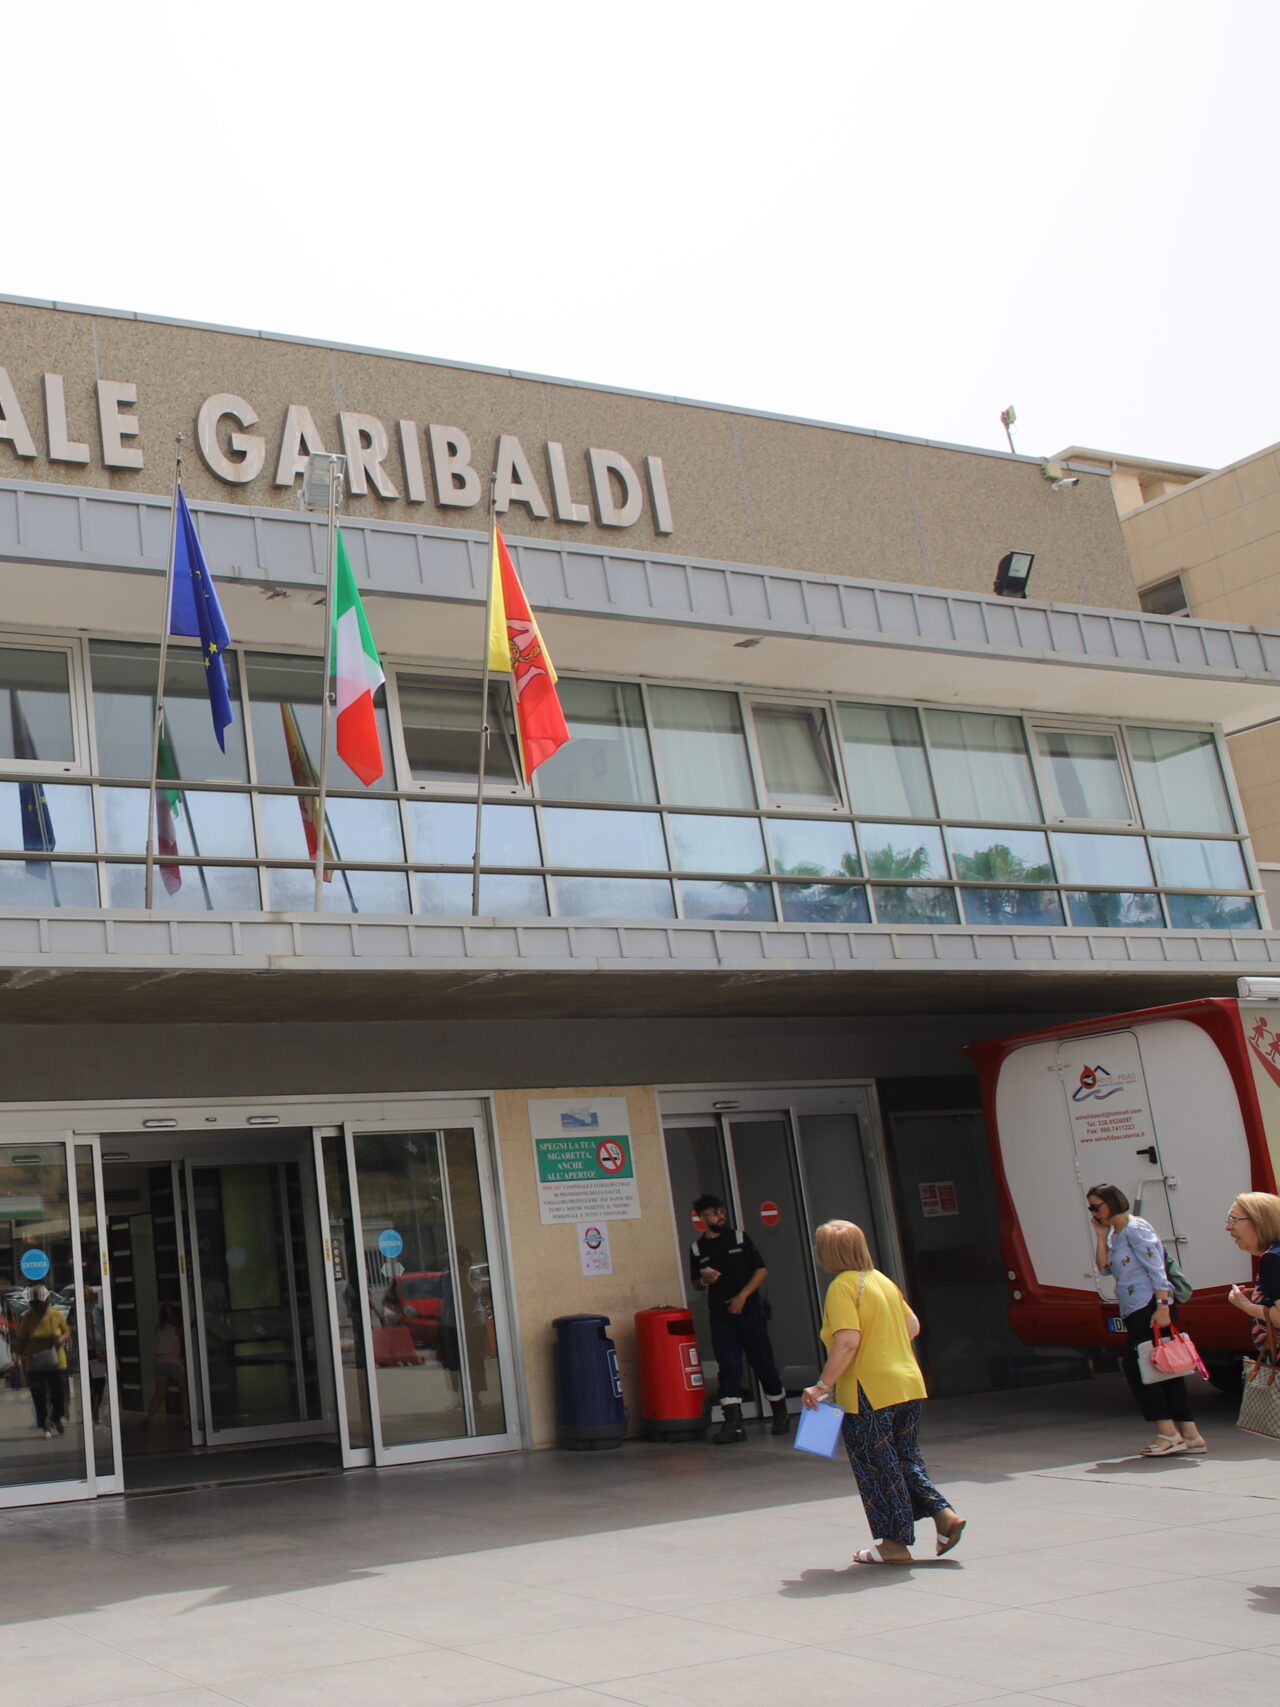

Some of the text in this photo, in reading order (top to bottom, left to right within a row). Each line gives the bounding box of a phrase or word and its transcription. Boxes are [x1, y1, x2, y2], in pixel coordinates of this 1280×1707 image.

[196, 393, 674, 536] GARIBALDI
[539, 1142, 567, 1151] SPEGNI
[580, 1141, 596, 1149] TUA
[557, 1161, 584, 1170] ANCHE
[23, 1261, 48, 1269] ENTRATA
